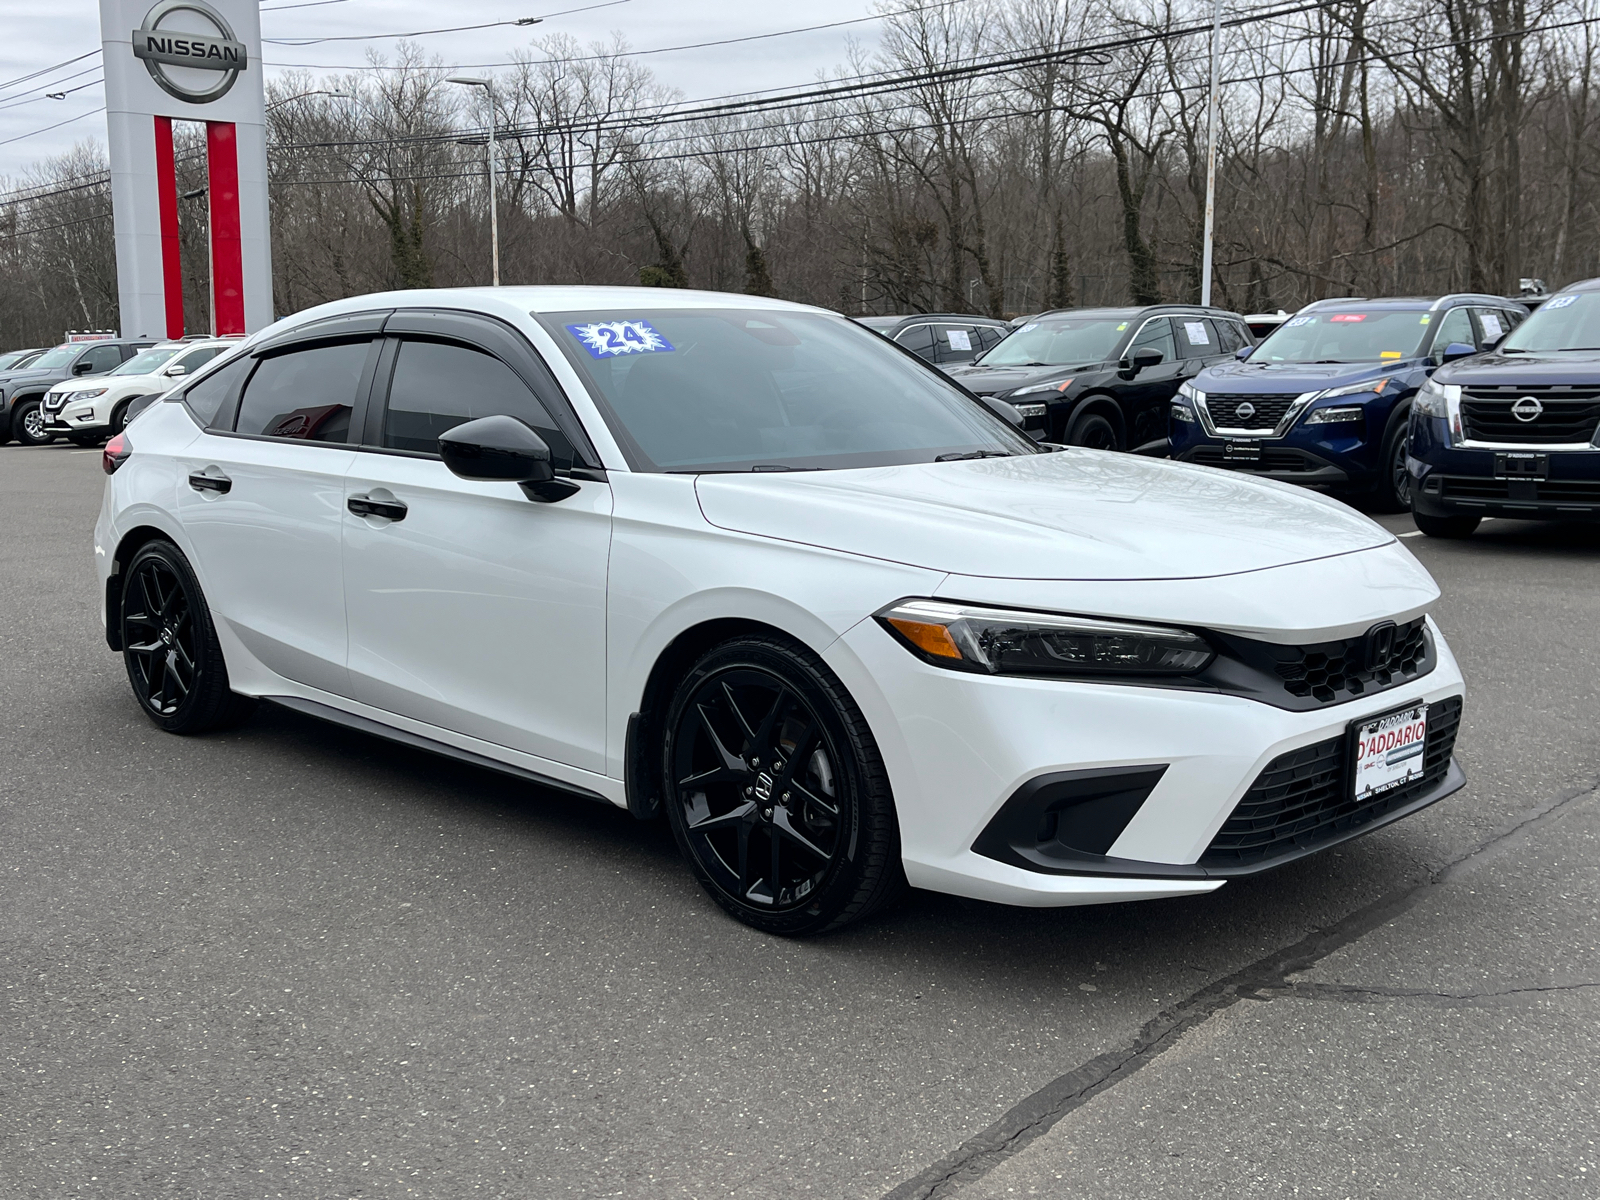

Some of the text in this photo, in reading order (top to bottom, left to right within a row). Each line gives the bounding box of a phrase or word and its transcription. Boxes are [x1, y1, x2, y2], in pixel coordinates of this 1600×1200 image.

[147, 36, 238, 62] NISSAN
[597, 325, 645, 348] 24
[1358, 721, 1425, 761] D'ADDARIO
[1364, 762, 1375, 770] GMC
[1375, 781, 1400, 794] SHELTON,
